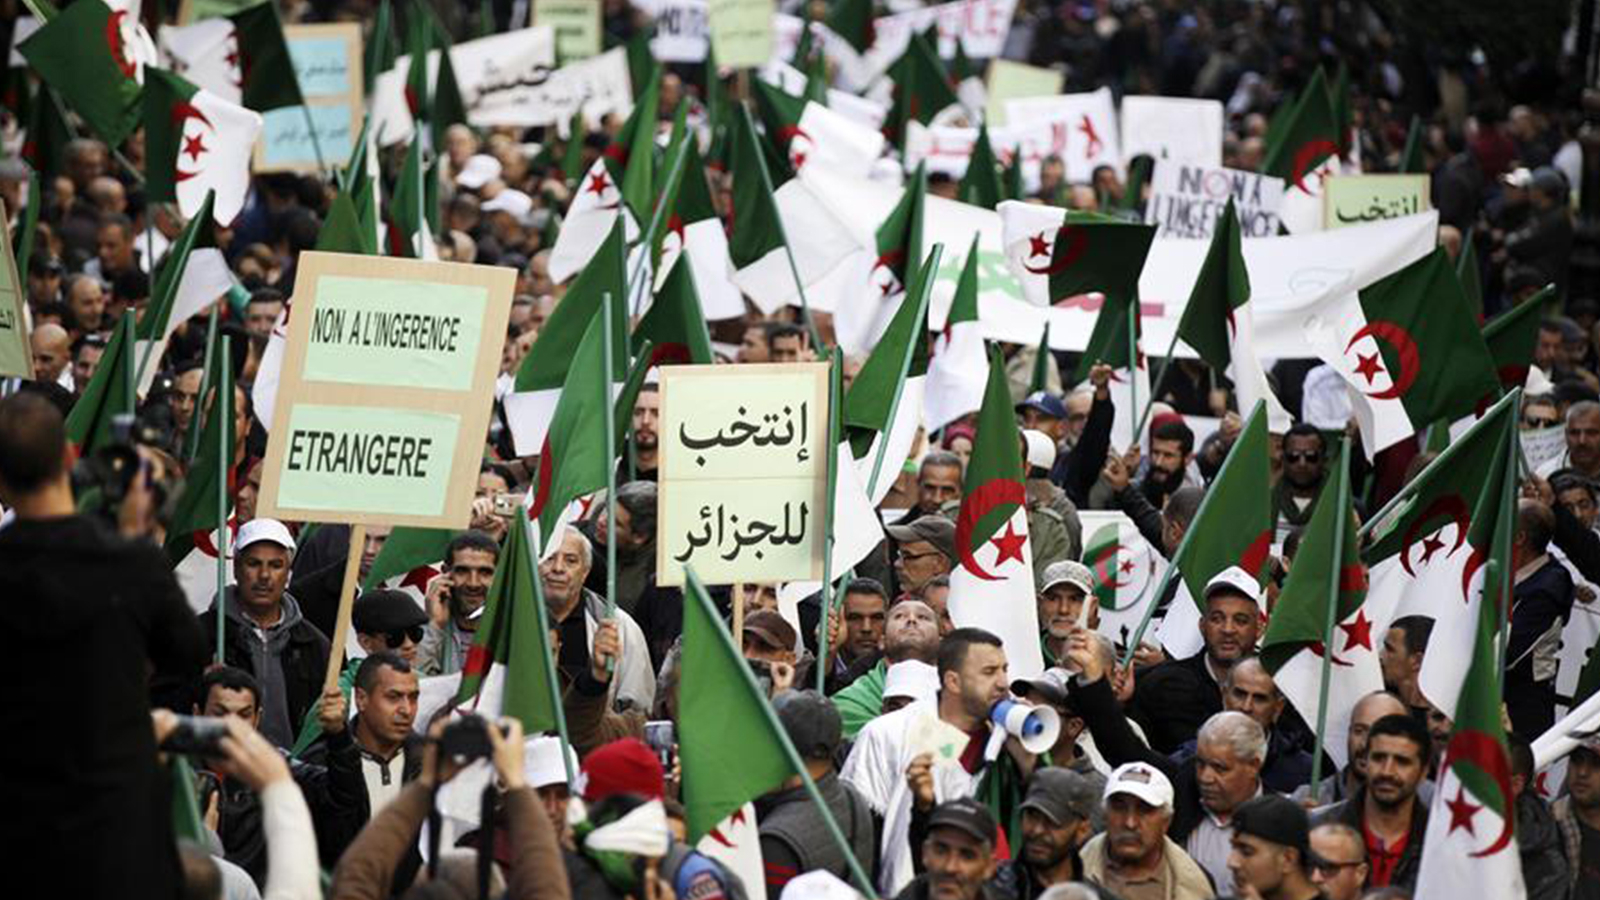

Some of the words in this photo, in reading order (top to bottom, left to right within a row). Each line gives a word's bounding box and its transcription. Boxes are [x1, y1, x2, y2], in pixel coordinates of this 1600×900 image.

[1179, 165, 1246, 201] NON
[311, 308, 346, 344] NON
[349, 310, 361, 345] A
[363, 311, 461, 352] L'INGERENCE
[287, 430, 432, 477] ETRANGERE
[679, 401, 809, 467] إنتخب
[674, 501, 809, 562] للجزائر
